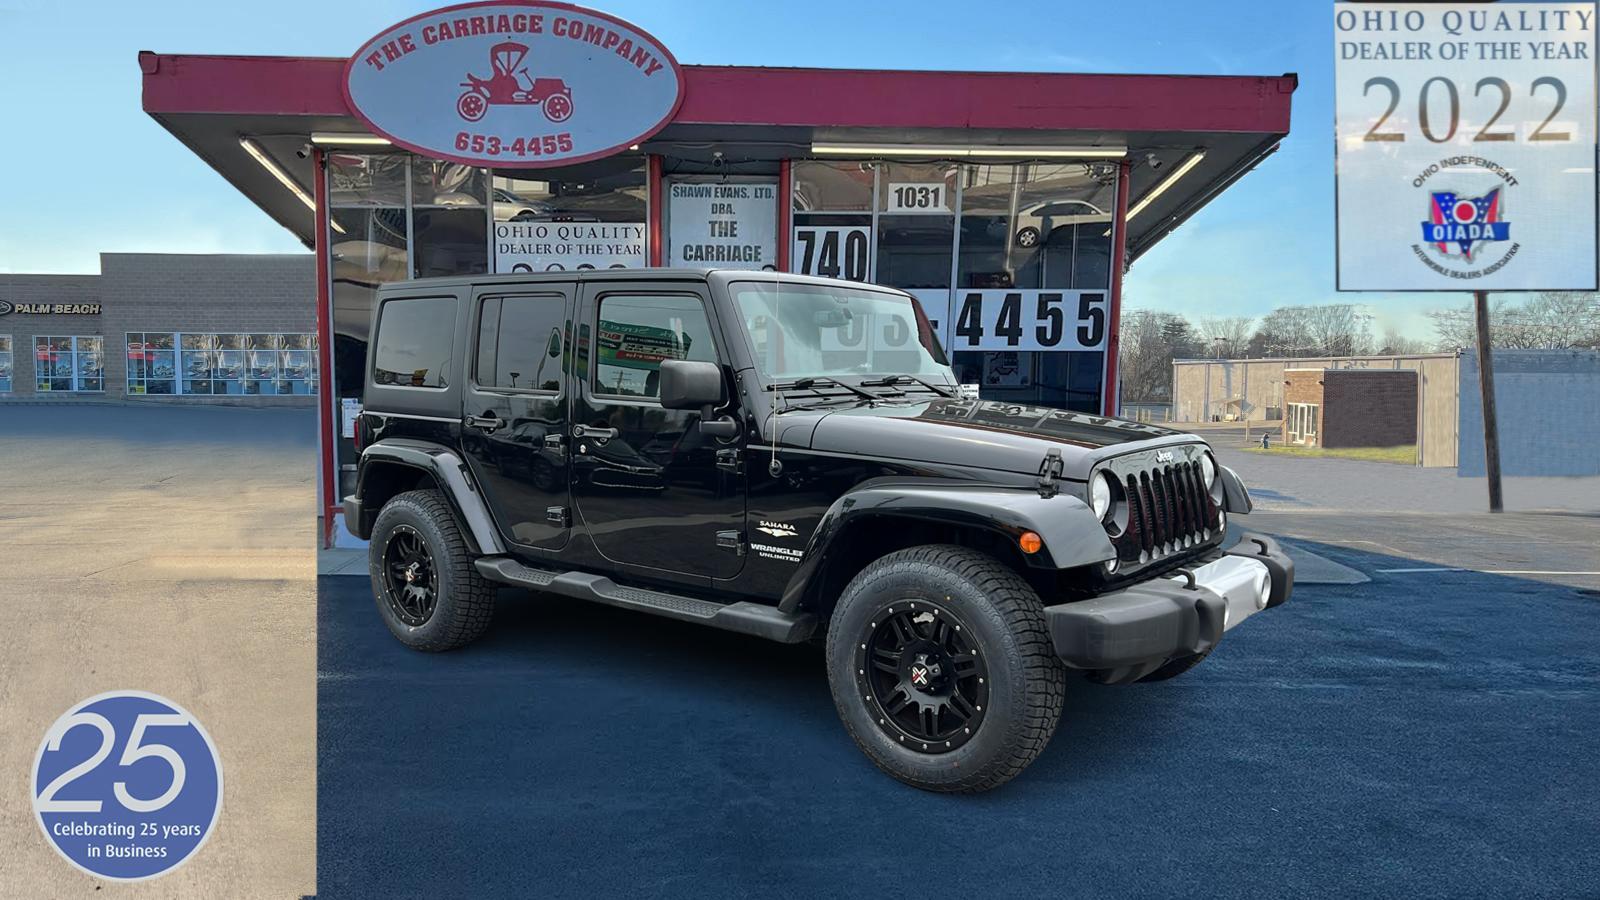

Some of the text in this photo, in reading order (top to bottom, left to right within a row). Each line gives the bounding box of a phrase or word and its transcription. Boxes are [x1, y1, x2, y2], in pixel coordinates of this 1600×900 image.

[1336, 10, 1592, 35] OHIO QUALITY
[366, 14, 663, 77] THE CARRIAGE COMPANY
[1340, 42, 1589, 60] DEALER OF THE YEAR
[1363, 76, 1571, 143] 2022
[455, 132, 573, 156] 653-4455
[1412, 156, 1519, 188] OHIO INDEPENDENT
[672, 186, 711, 198] SHAWN
[754, 187, 775, 199] LTD.
[894, 186, 940, 208] 1031
[711, 203, 736, 215] DBA.
[497, 226, 643, 240] OHIO QUALITY
[708, 220, 738, 238] THE
[1432, 224, 1495, 240] OIADA
[500, 243, 641, 255] DEALER OF THE YEAR
[683, 244, 762, 262] CARRIAGE
[797, 230, 868, 282] 740
[1411, 242, 1520, 280] AUTOMOBILE DEALERS ASSOCIATION
[14, 303, 100, 314] PALM BEACH
[759, 520, 796, 531] SAHARA
[759, 552, 800, 562] UNLIMITED
